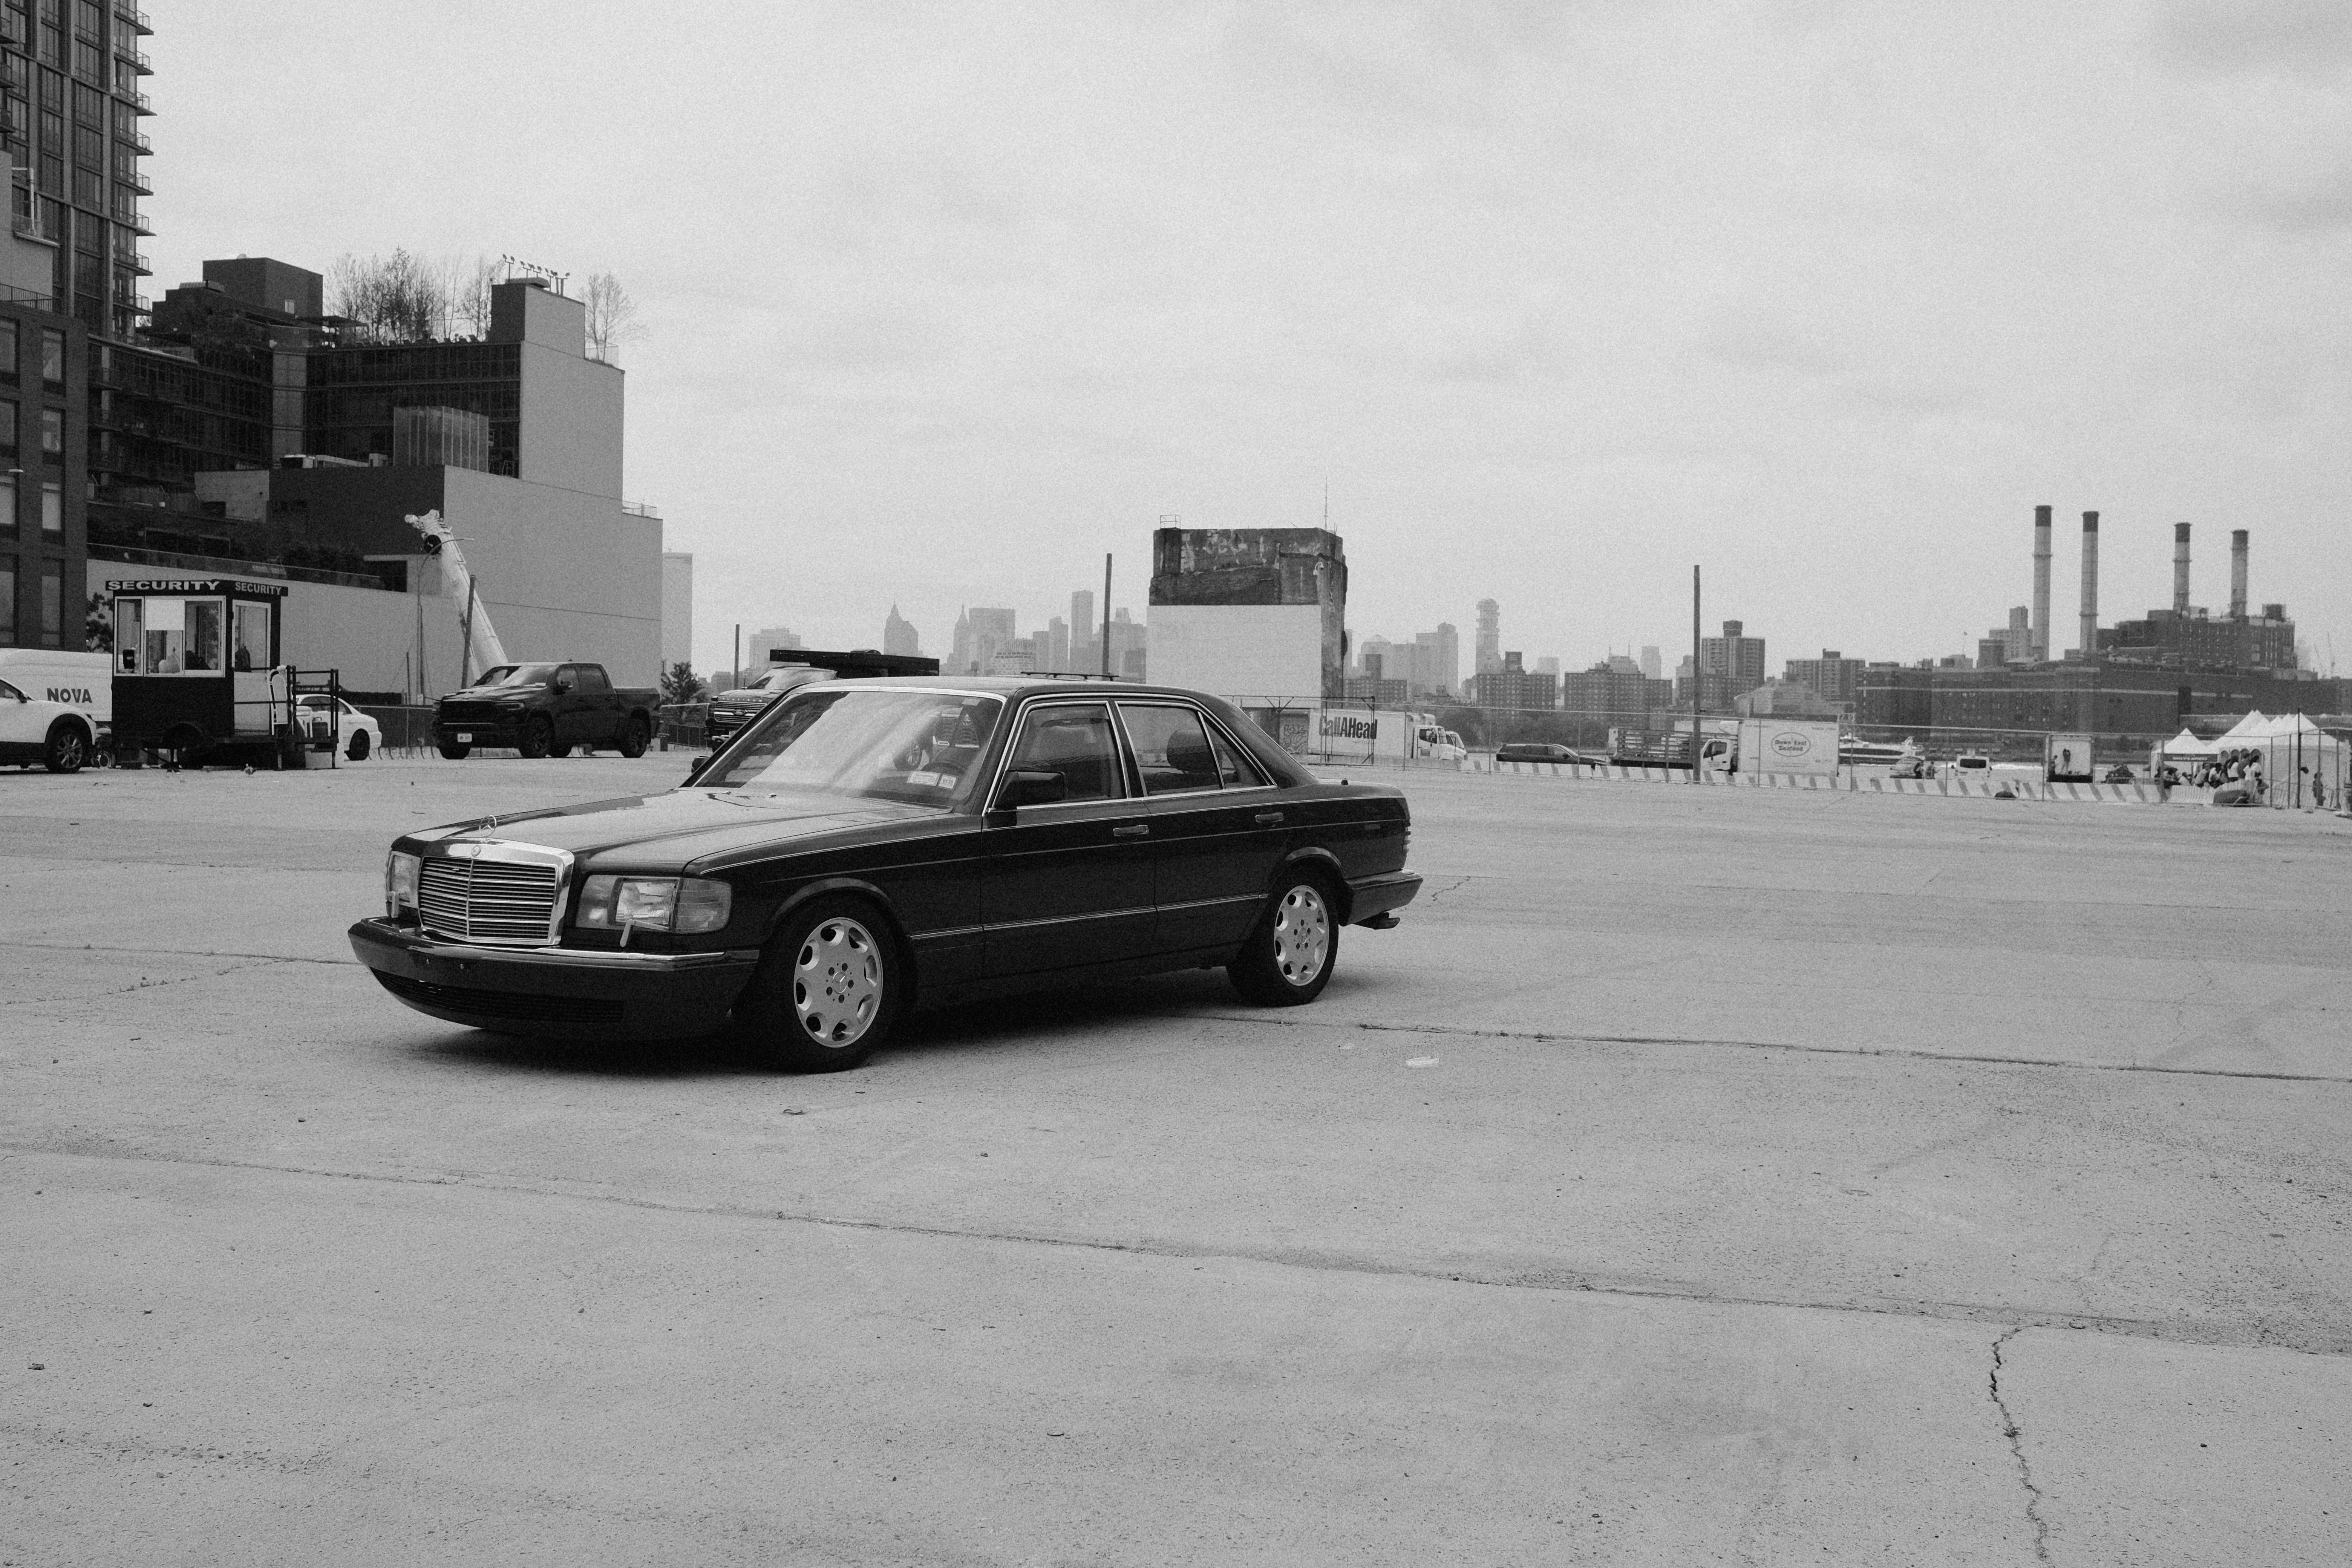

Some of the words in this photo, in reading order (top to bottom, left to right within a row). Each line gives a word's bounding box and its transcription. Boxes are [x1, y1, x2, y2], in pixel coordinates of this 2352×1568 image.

[108, 581, 220, 590] SECURITY
[235, 582, 282, 596] SECURITY
[47, 688, 92, 703] NOVA
[1319, 716, 1378, 740] CallAHead
